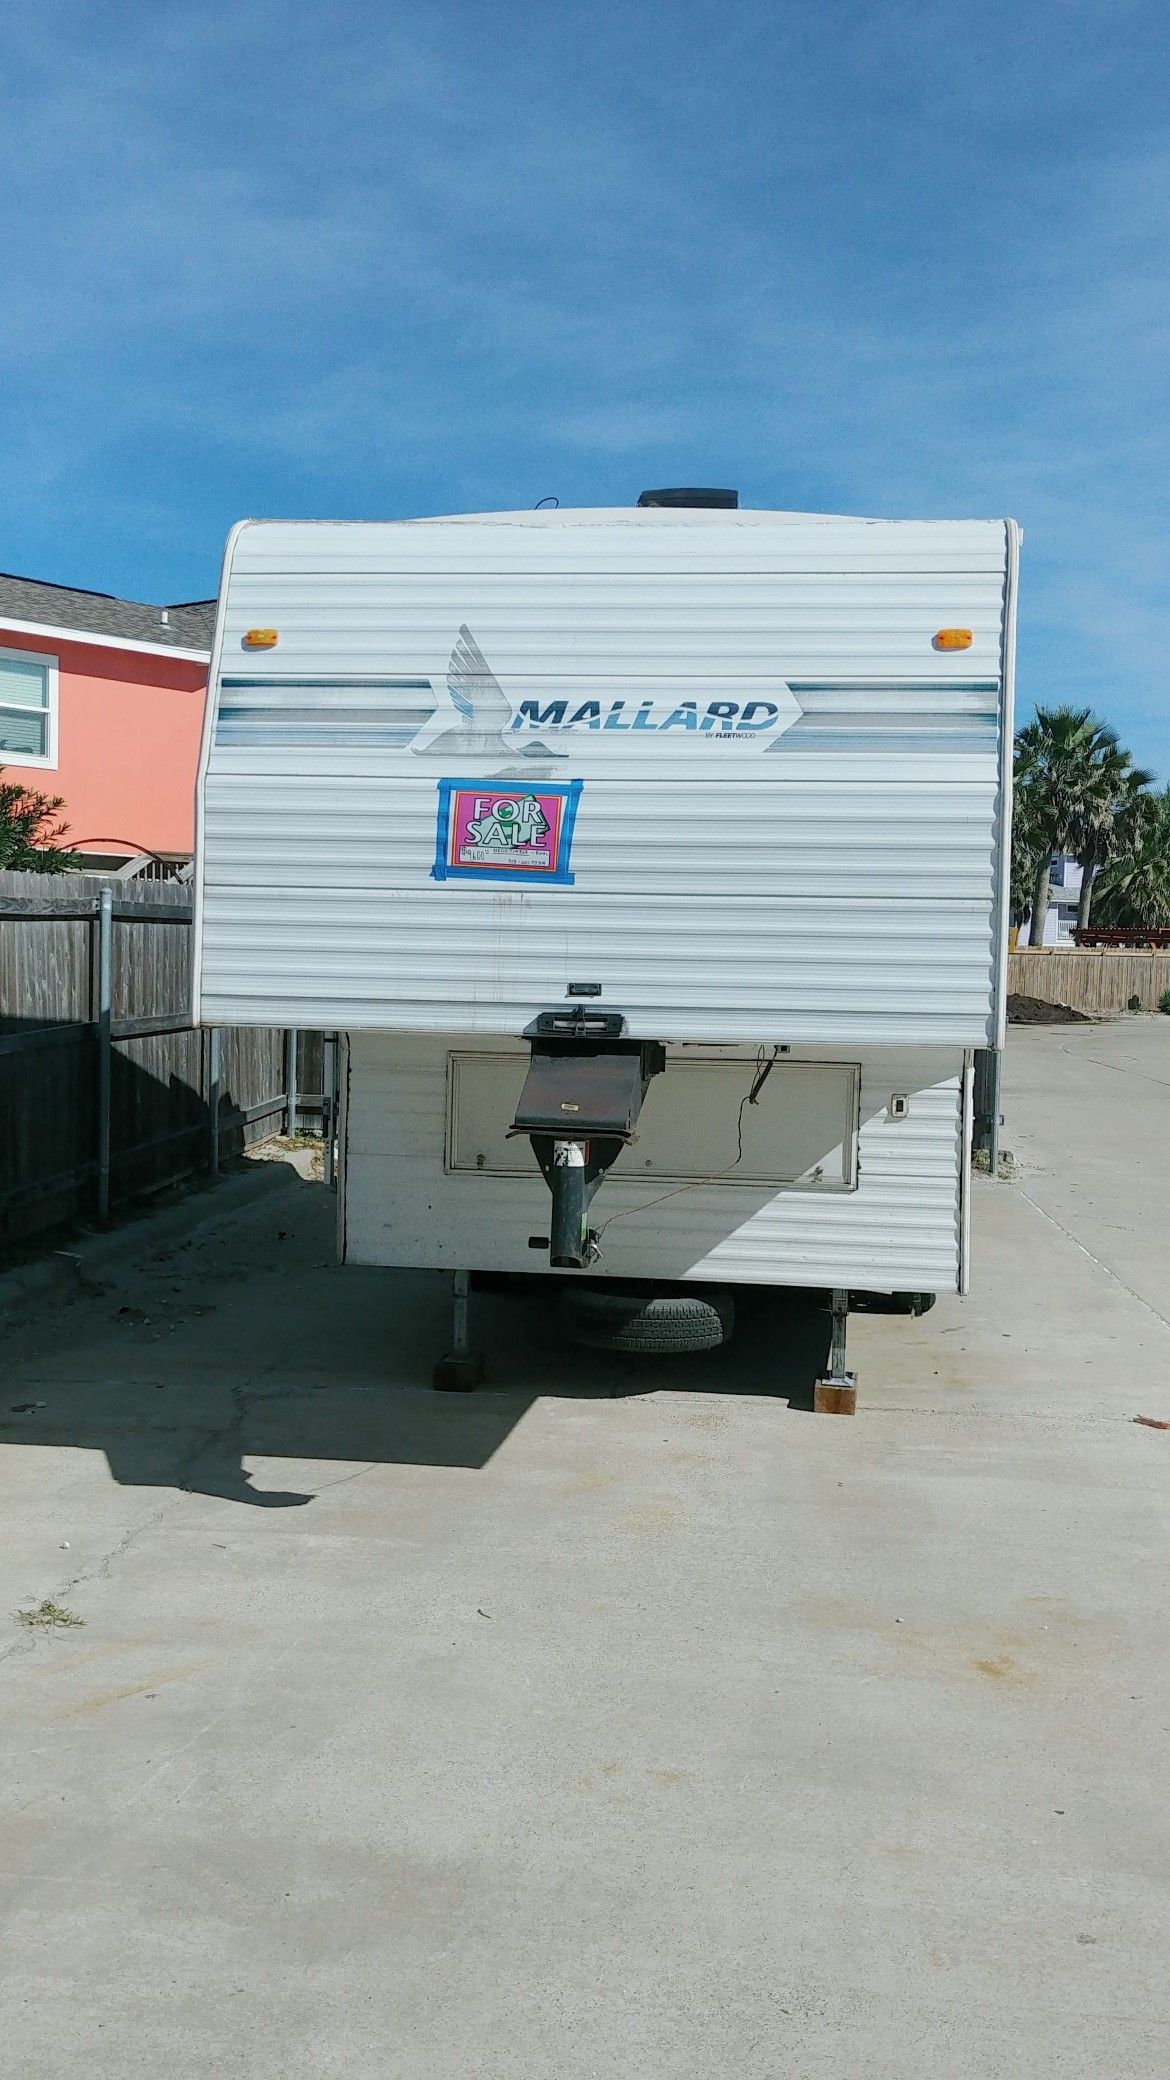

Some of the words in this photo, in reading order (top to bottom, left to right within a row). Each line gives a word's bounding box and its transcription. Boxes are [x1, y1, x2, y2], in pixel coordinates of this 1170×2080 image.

[510, 700, 780, 731] MALLARD
[473, 798, 543, 824] FOR
[464, 821, 546, 847] SALE
